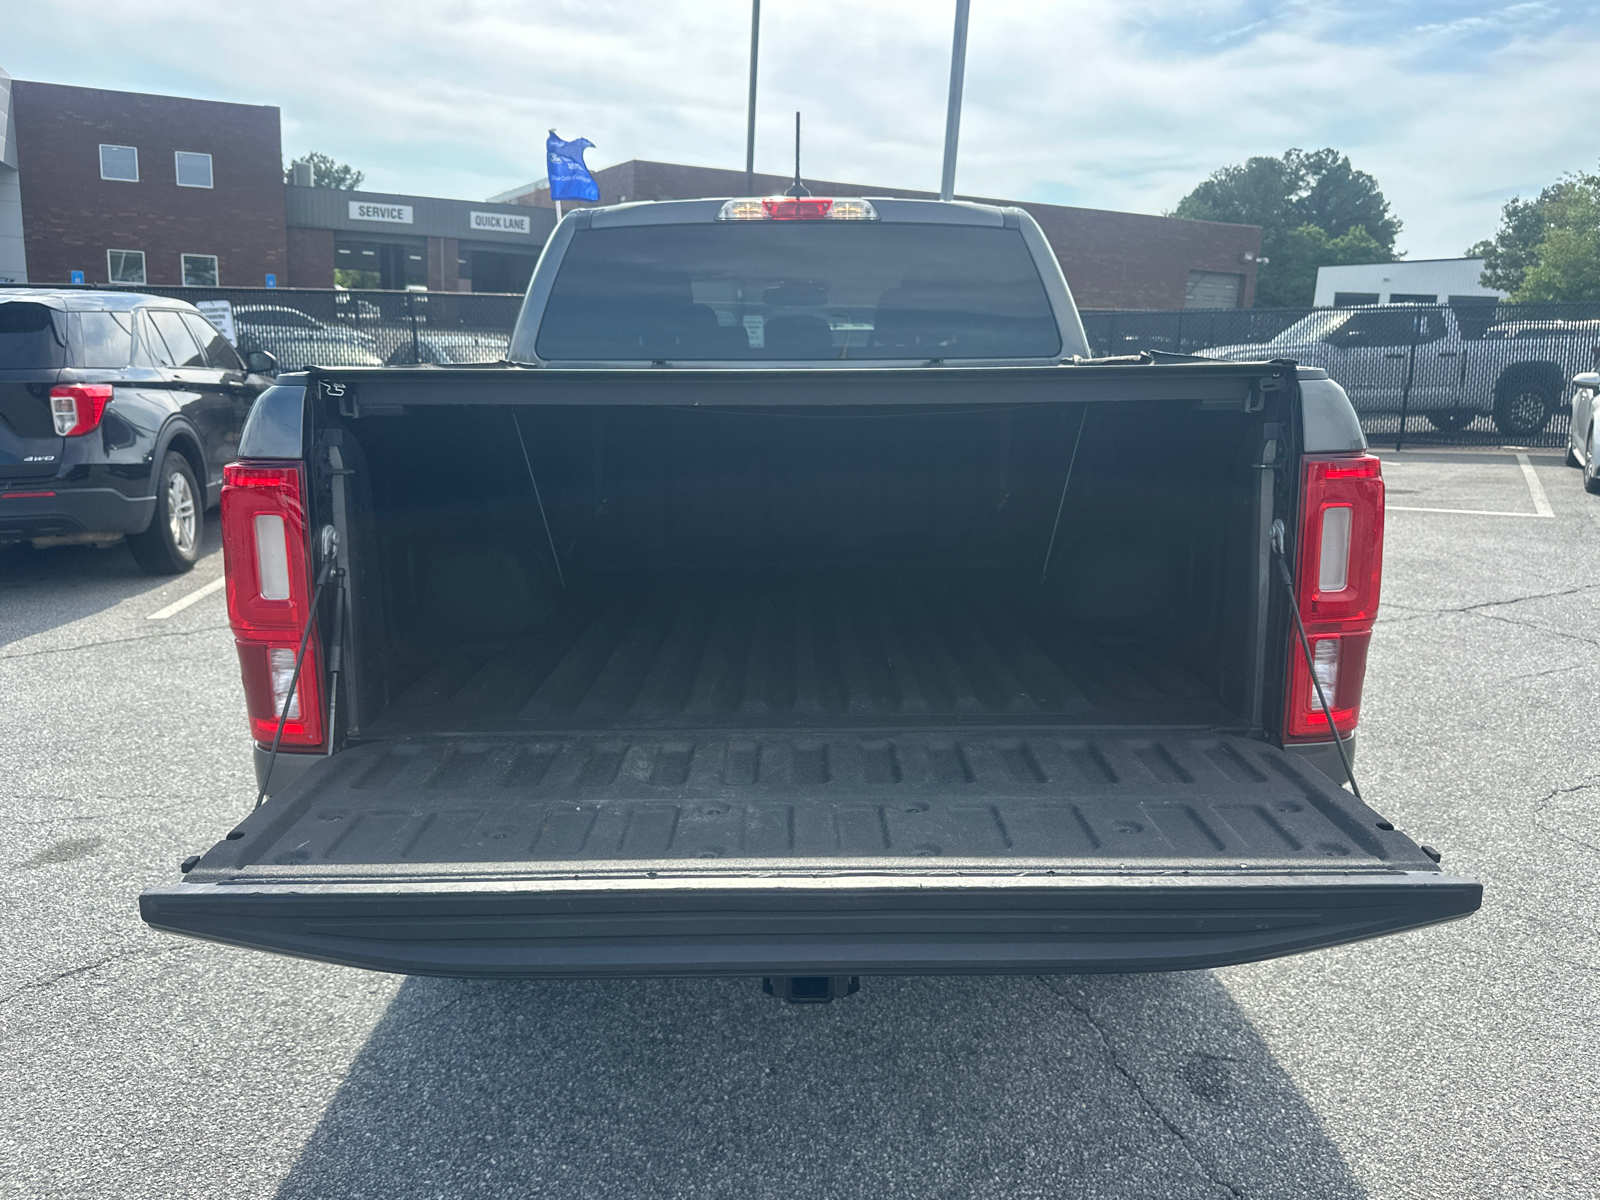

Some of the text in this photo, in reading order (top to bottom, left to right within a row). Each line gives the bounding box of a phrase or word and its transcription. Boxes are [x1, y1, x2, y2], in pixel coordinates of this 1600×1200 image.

[358, 205, 404, 220] SERVICE
[475, 215, 526, 231] QUICK LANE
